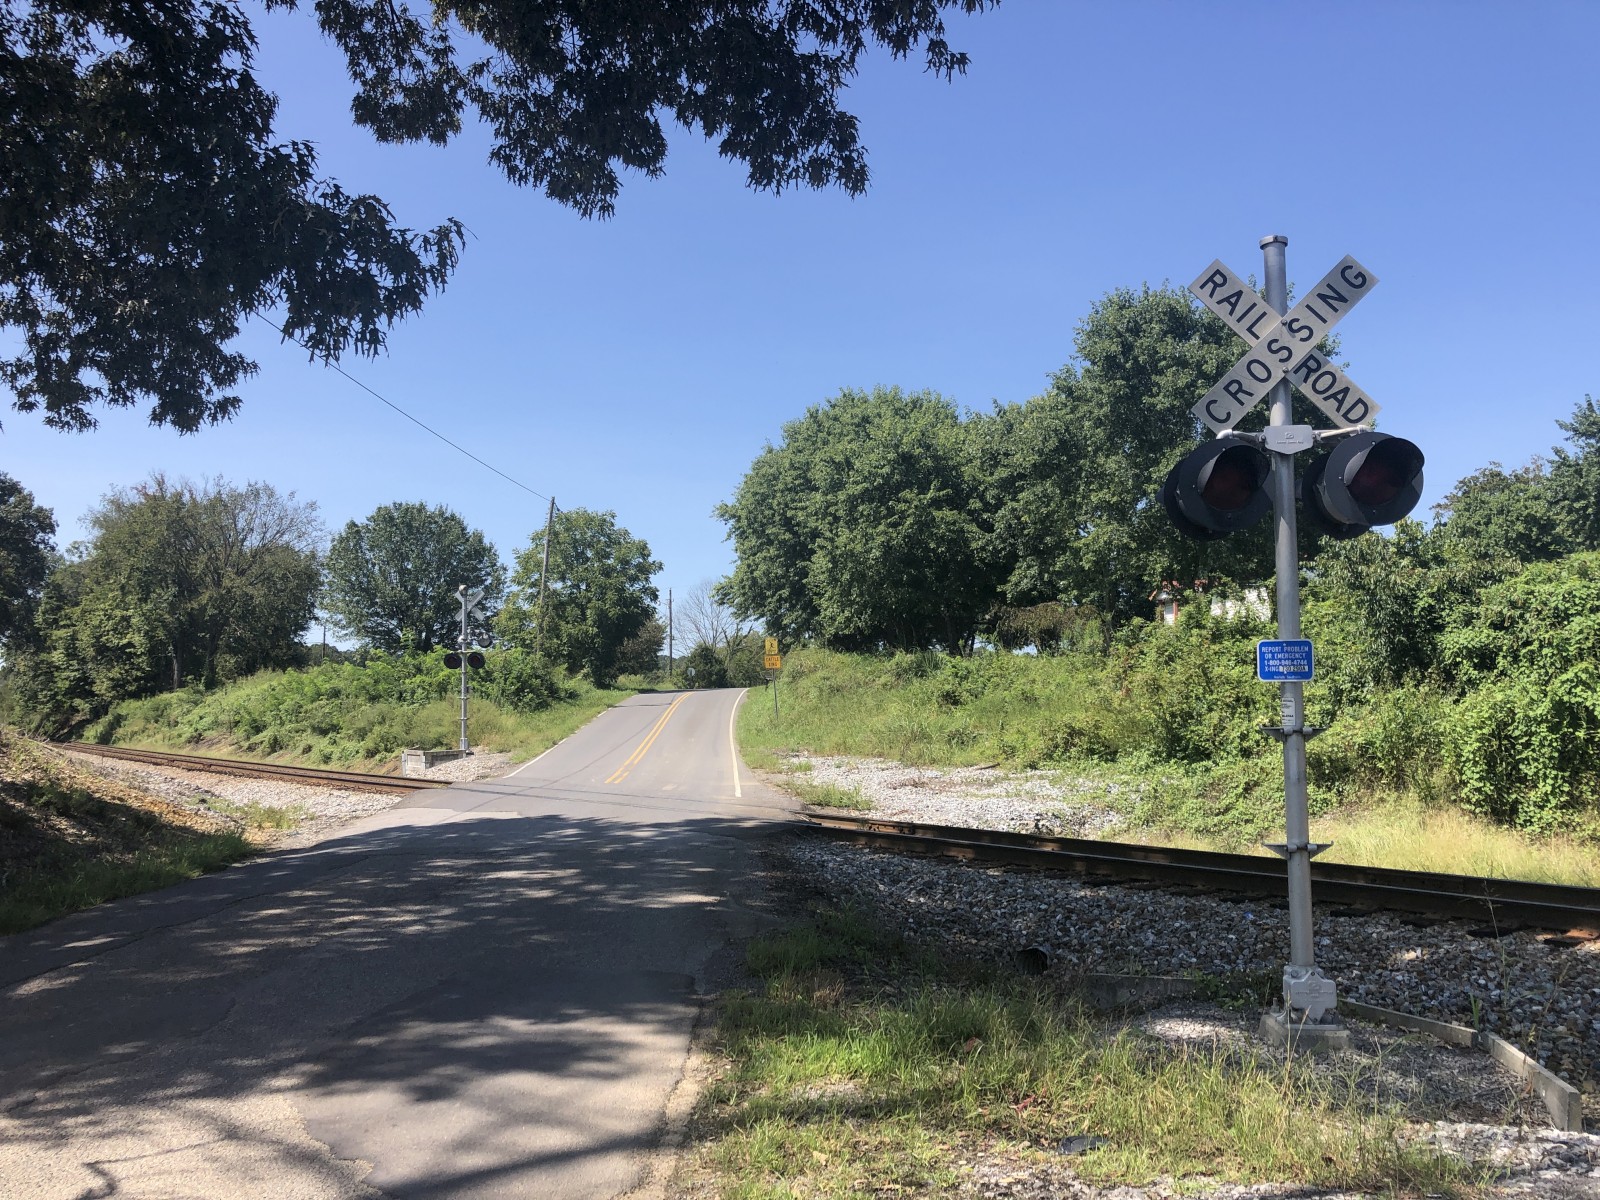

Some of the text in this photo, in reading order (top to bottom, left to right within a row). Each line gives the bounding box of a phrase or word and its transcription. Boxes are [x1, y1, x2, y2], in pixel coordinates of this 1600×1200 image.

[1199, 268, 1369, 424] RAIL ROAD
[1205, 264, 1367, 424] CROSSING
